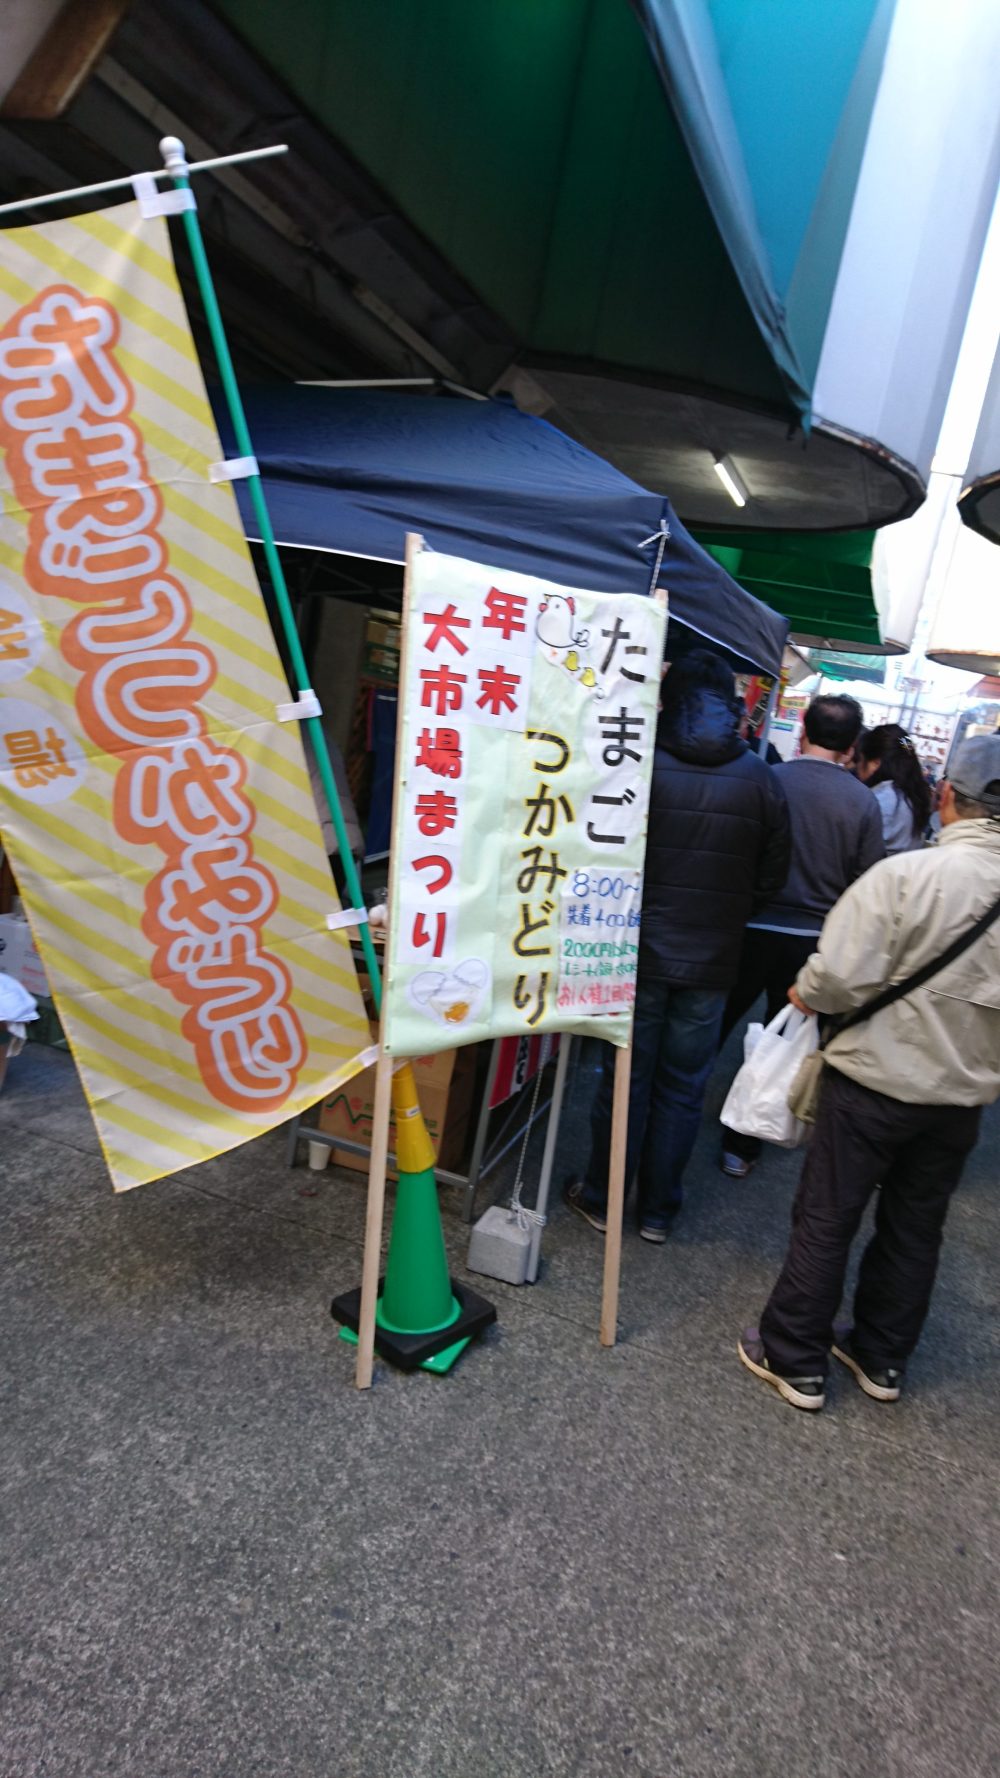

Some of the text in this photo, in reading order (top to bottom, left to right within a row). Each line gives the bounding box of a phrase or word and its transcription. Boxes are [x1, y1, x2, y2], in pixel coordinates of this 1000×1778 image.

[411, 603, 471, 958] 大市場まつり
[475, 586, 528, 715] 年末
[587, 616, 648, 845] たまご
[512, 728, 576, 1028] つかみどり
